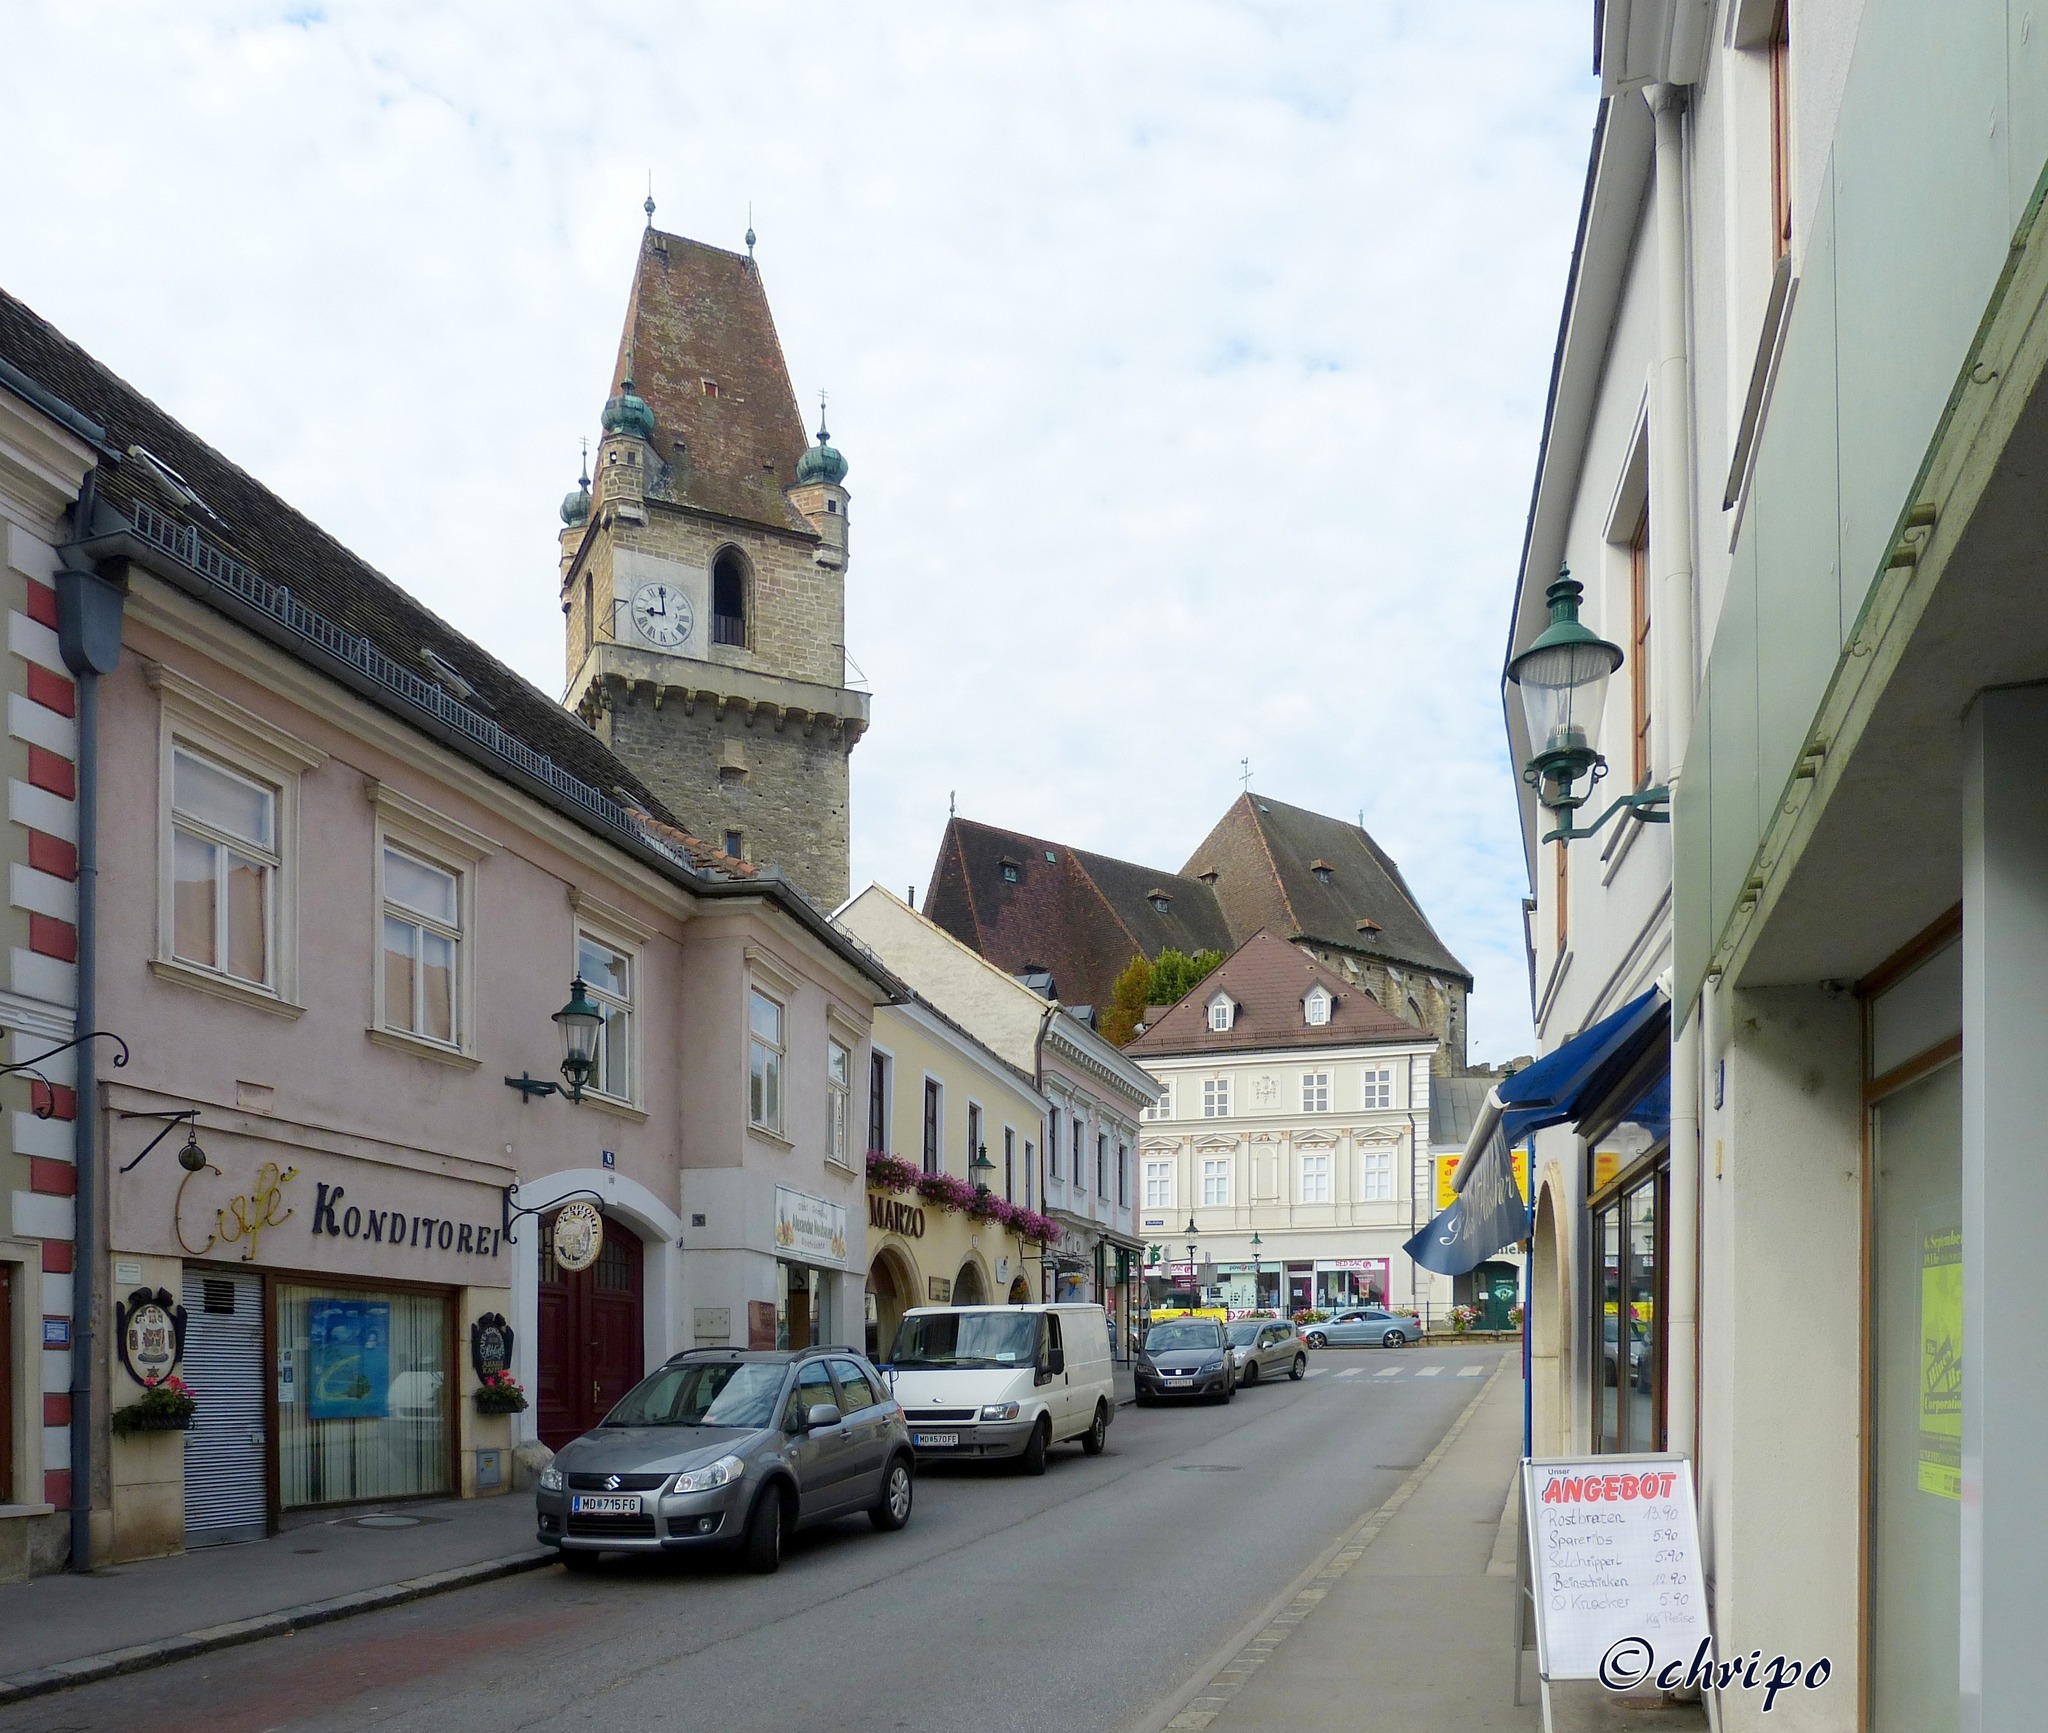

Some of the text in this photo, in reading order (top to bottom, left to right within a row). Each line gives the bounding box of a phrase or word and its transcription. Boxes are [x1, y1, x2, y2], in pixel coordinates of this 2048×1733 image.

[607, 1153, 613, 1163] 6
[312, 1182, 501, 1257] KONDITOREI
[868, 1194, 926, 1238] MARZO
[1547, 1468, 1570, 1476] Unser
[1541, 1472, 1677, 1504] ANGEBOT
[582, 1498, 596, 1510] MD
[1540, 1504, 1679, 1527] Rostbraten 13.90
[1653, 1528, 1679, 1542] 5.90
[1655, 1549, 1684, 1563] 5.90
[1659, 1592, 1689, 1606] 5.90
